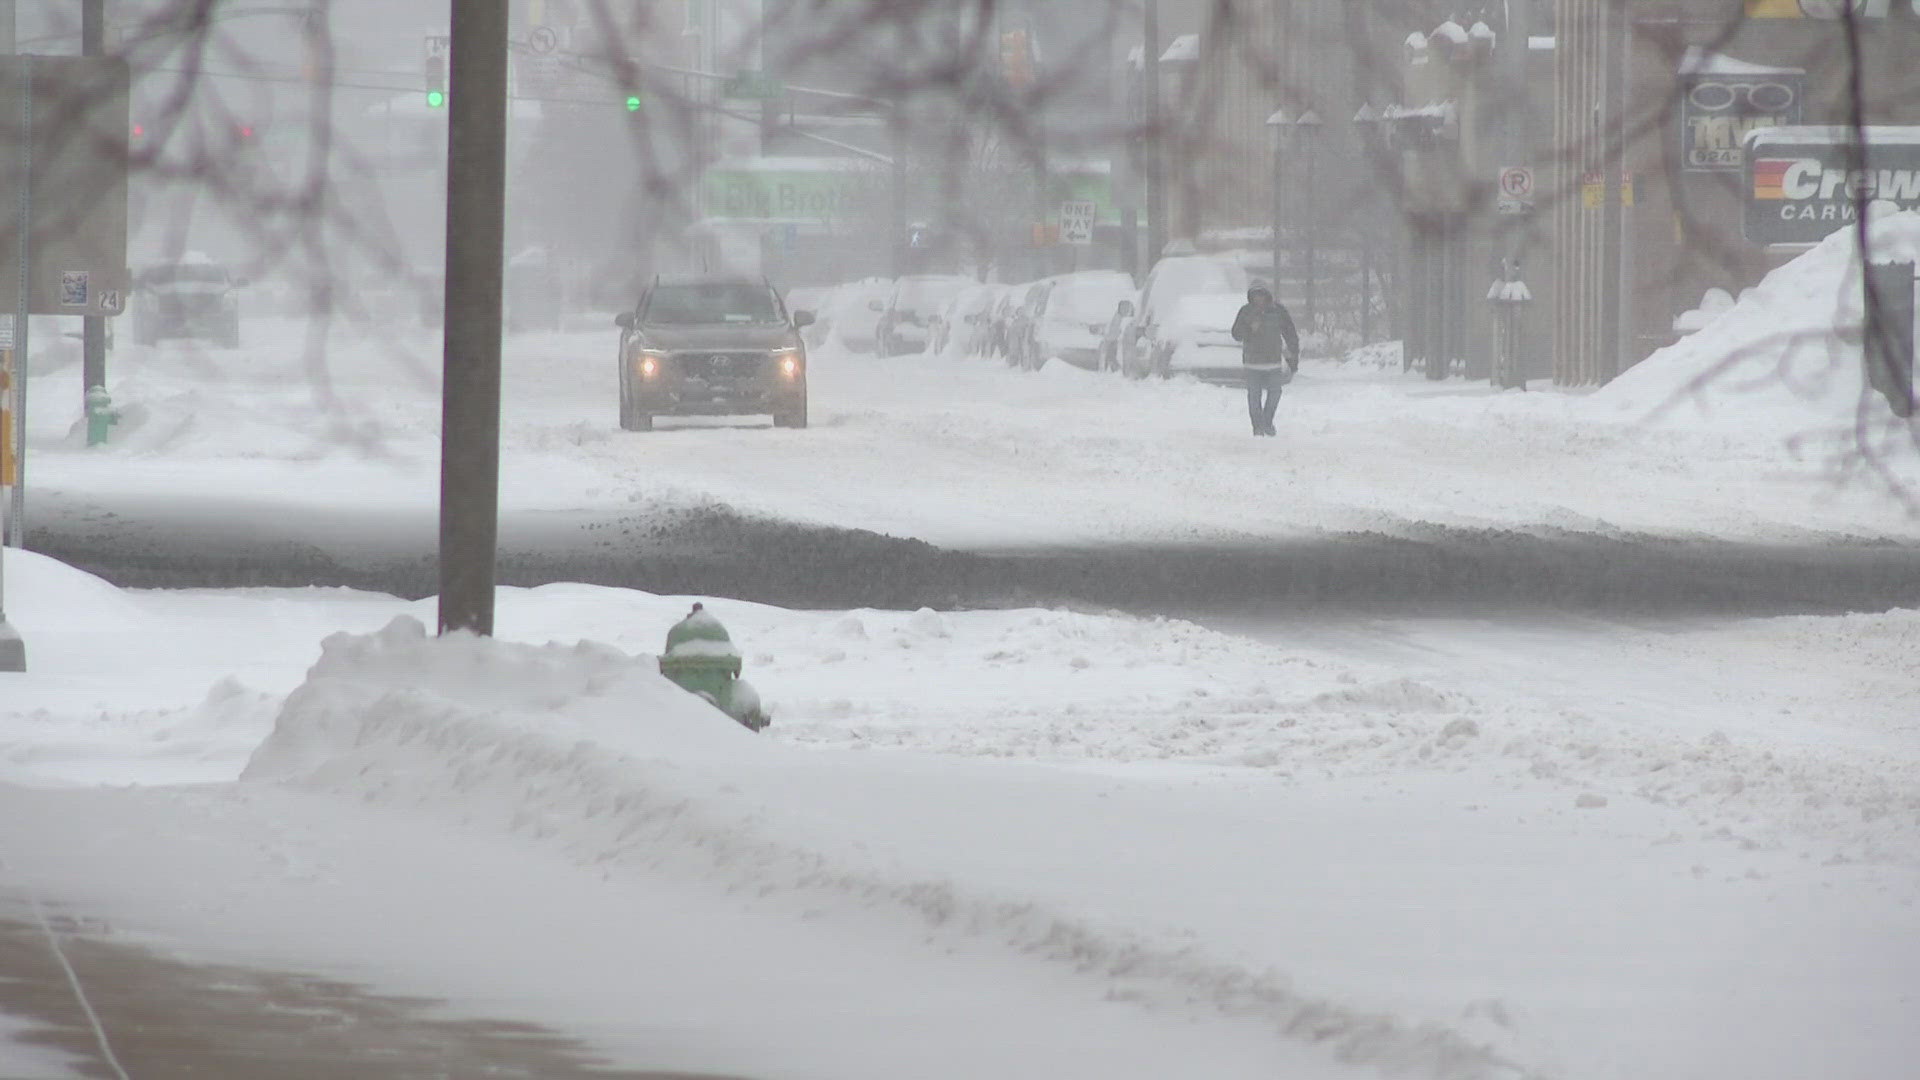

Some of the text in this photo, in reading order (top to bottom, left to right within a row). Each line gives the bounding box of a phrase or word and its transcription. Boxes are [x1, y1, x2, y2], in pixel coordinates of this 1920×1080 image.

[1782, 158, 1920, 200] Crew
[1065, 204, 1091, 216] ONE
[1781, 204, 1858, 220] CARW
[1063, 218, 1091, 231] WAY
